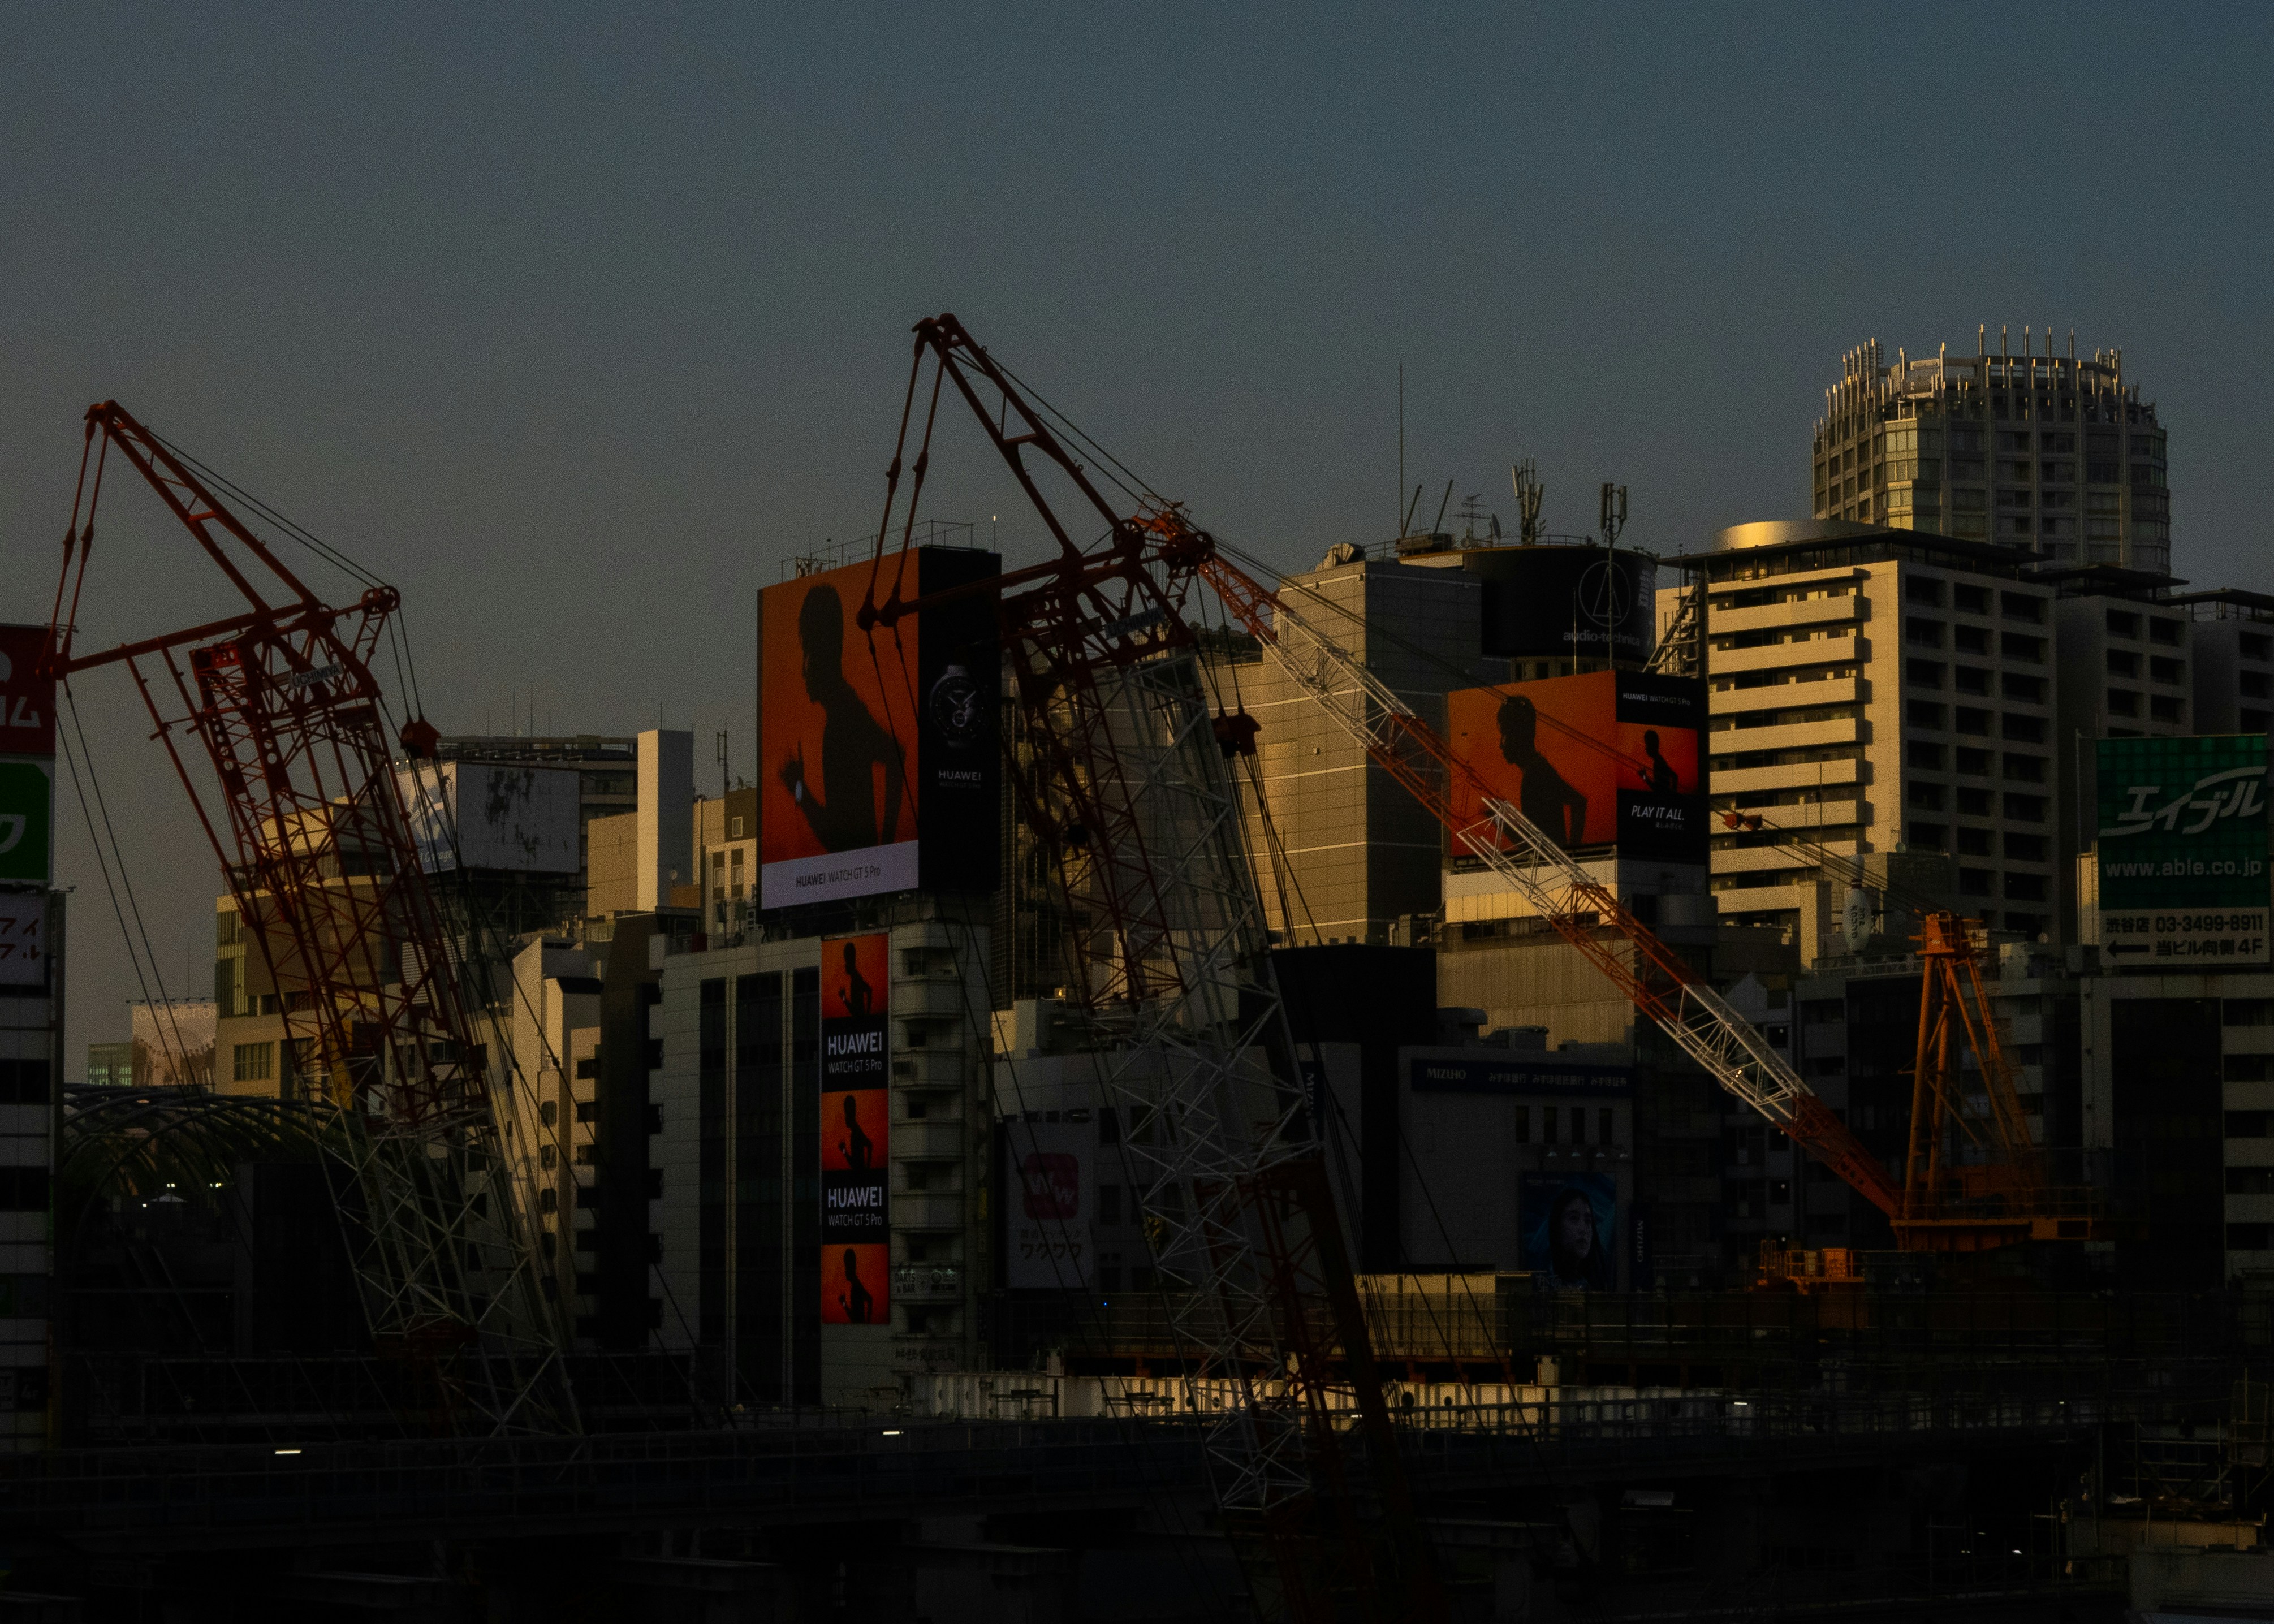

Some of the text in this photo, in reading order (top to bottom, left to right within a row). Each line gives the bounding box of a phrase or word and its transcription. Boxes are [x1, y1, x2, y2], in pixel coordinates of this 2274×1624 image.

[1108, 608, 1163, 636] UCHIMIYA
[293, 664, 339, 687] UCHIMIYA
[1622, 692, 1648, 702] HUAWEI
[1649, 694, 1669, 704] WATCH
[1669, 696, 1677, 705] GT
[938, 770, 981, 781] HUAWEI
[2099, 767, 2267, 837] エイブル
[1630, 805, 1685, 821] PLAY IT ALL.
[2105, 857, 2262, 878] www.able.co.jp
[796, 873, 826, 888] HUAWEI
[828, 869, 852, 883] WATCH
[854, 867, 864, 880] GT
[870, 865, 881, 876] Pro
[2106, 915, 2262, 933] 渋谷店 03-3499-8911
[2156, 939, 2262, 956] 当ビル向側 4F
[827, 1031, 882, 1056] HUAWEI
[827, 1058, 882, 1074] WATCH GT 5 Pro
[1426, 1067, 1467, 1081] MIZUHO
[827, 1186, 882, 1208] HUAWEI
[827, 1212, 882, 1226] WATCH GT 5 Pro
[895, 1273, 915, 1283] DARTS
[903, 1284, 916, 1293] BAR
